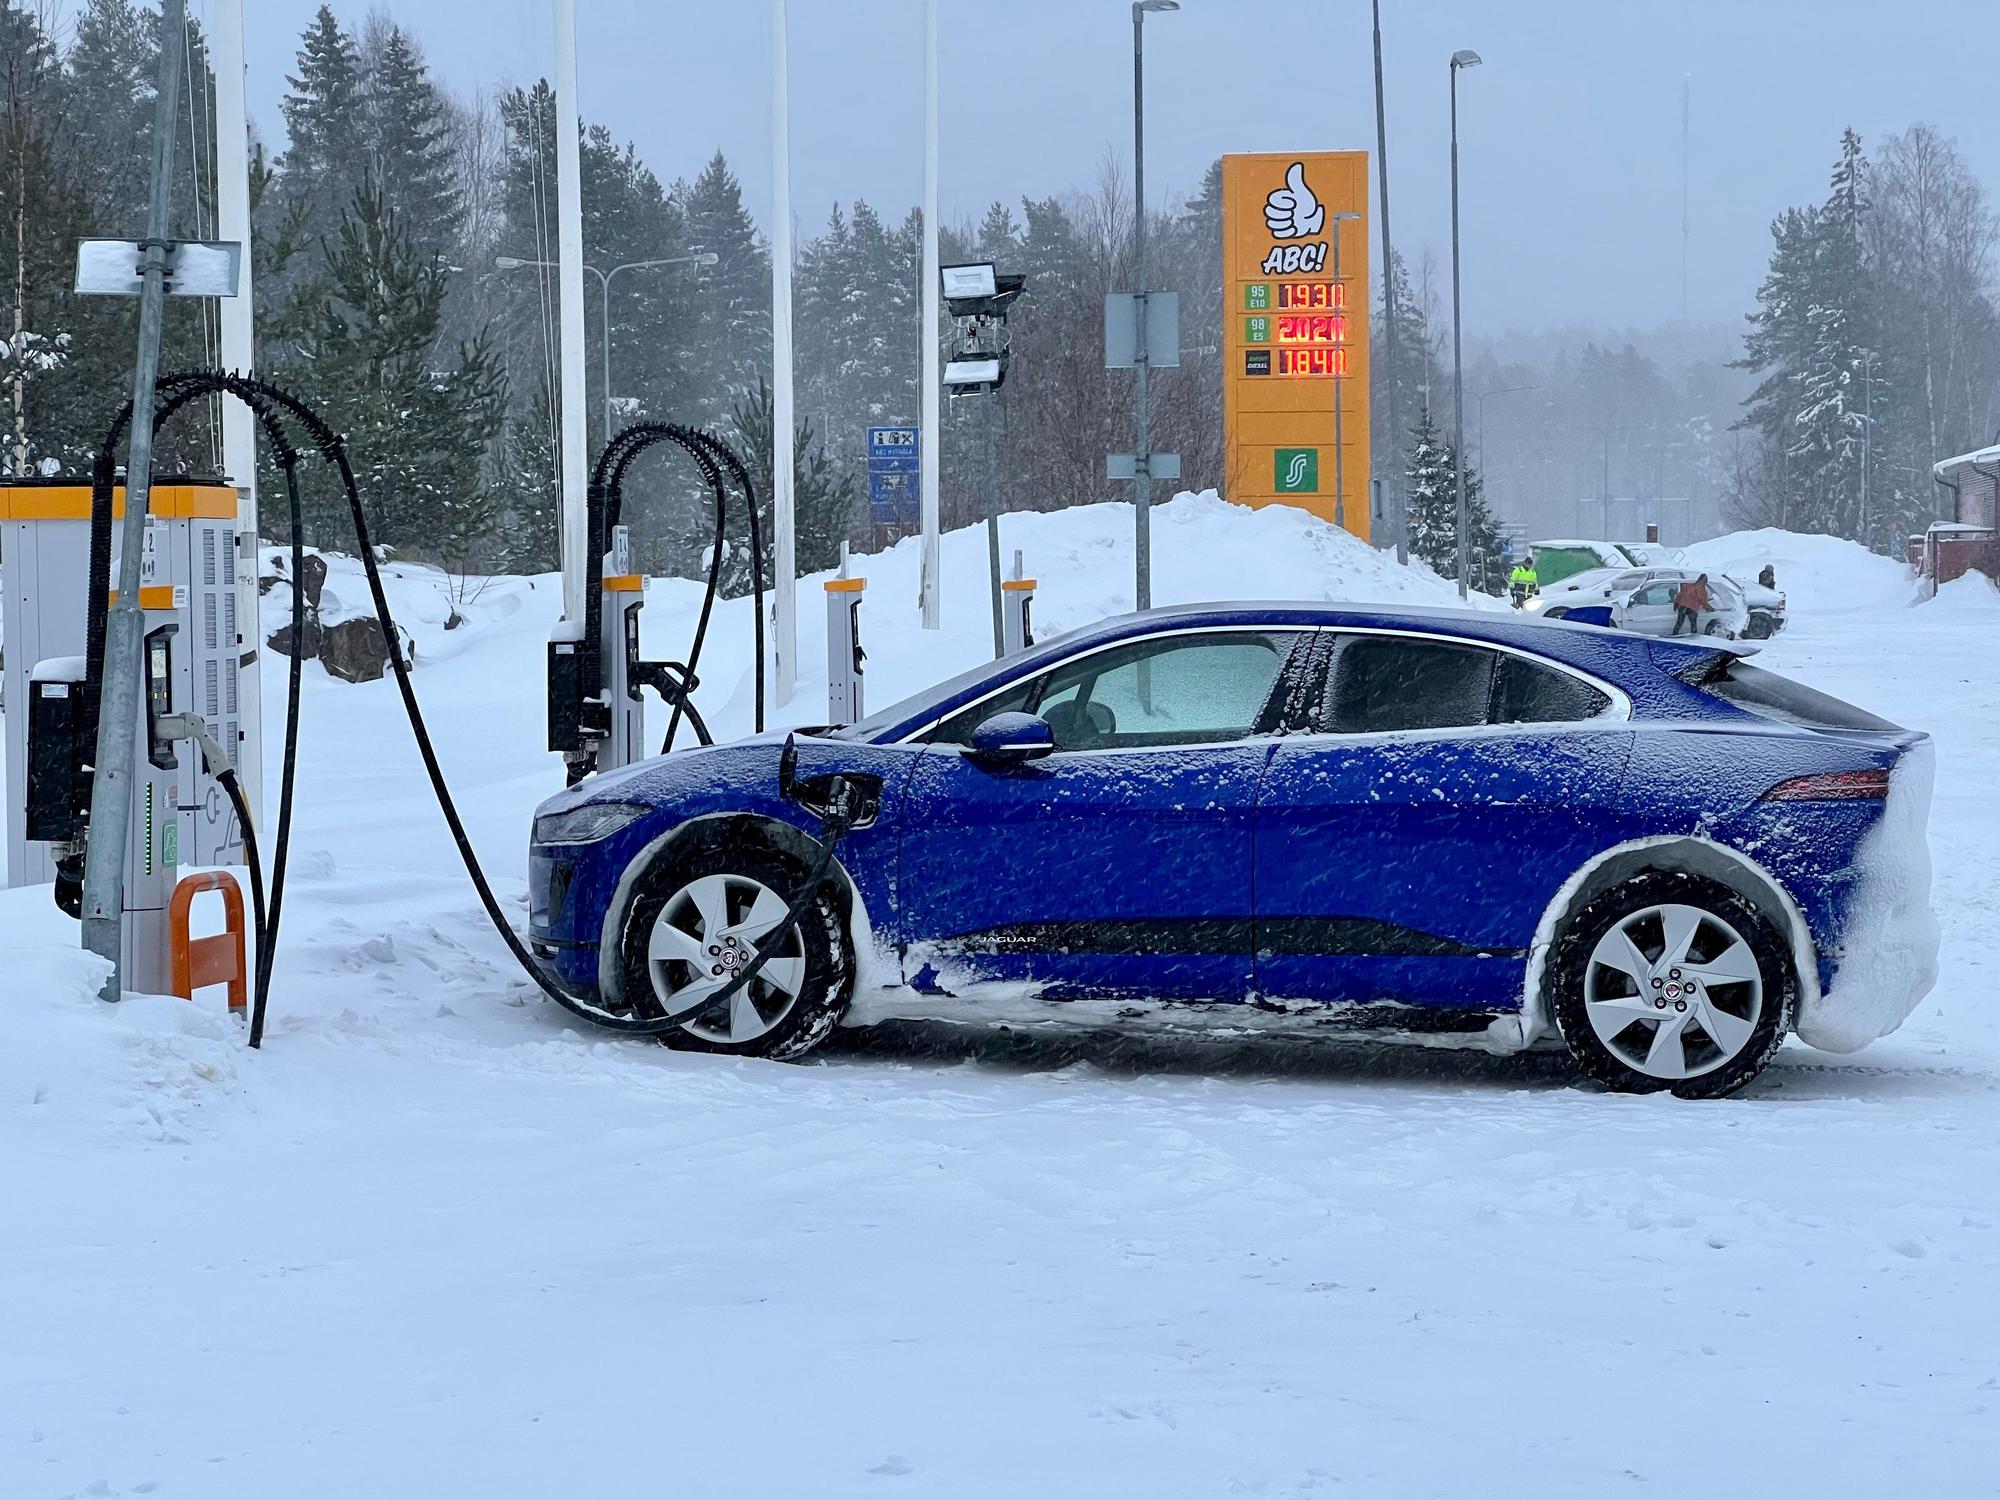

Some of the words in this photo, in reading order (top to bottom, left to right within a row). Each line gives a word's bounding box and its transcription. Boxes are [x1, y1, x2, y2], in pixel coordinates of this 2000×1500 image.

[1263, 243, 1328, 274] ABC!
[1251, 285, 1264, 297] 95
[1250, 299, 1265, 308] E10
[1251, 318, 1264, 330] 98
[1253, 332, 1263, 341] E5
